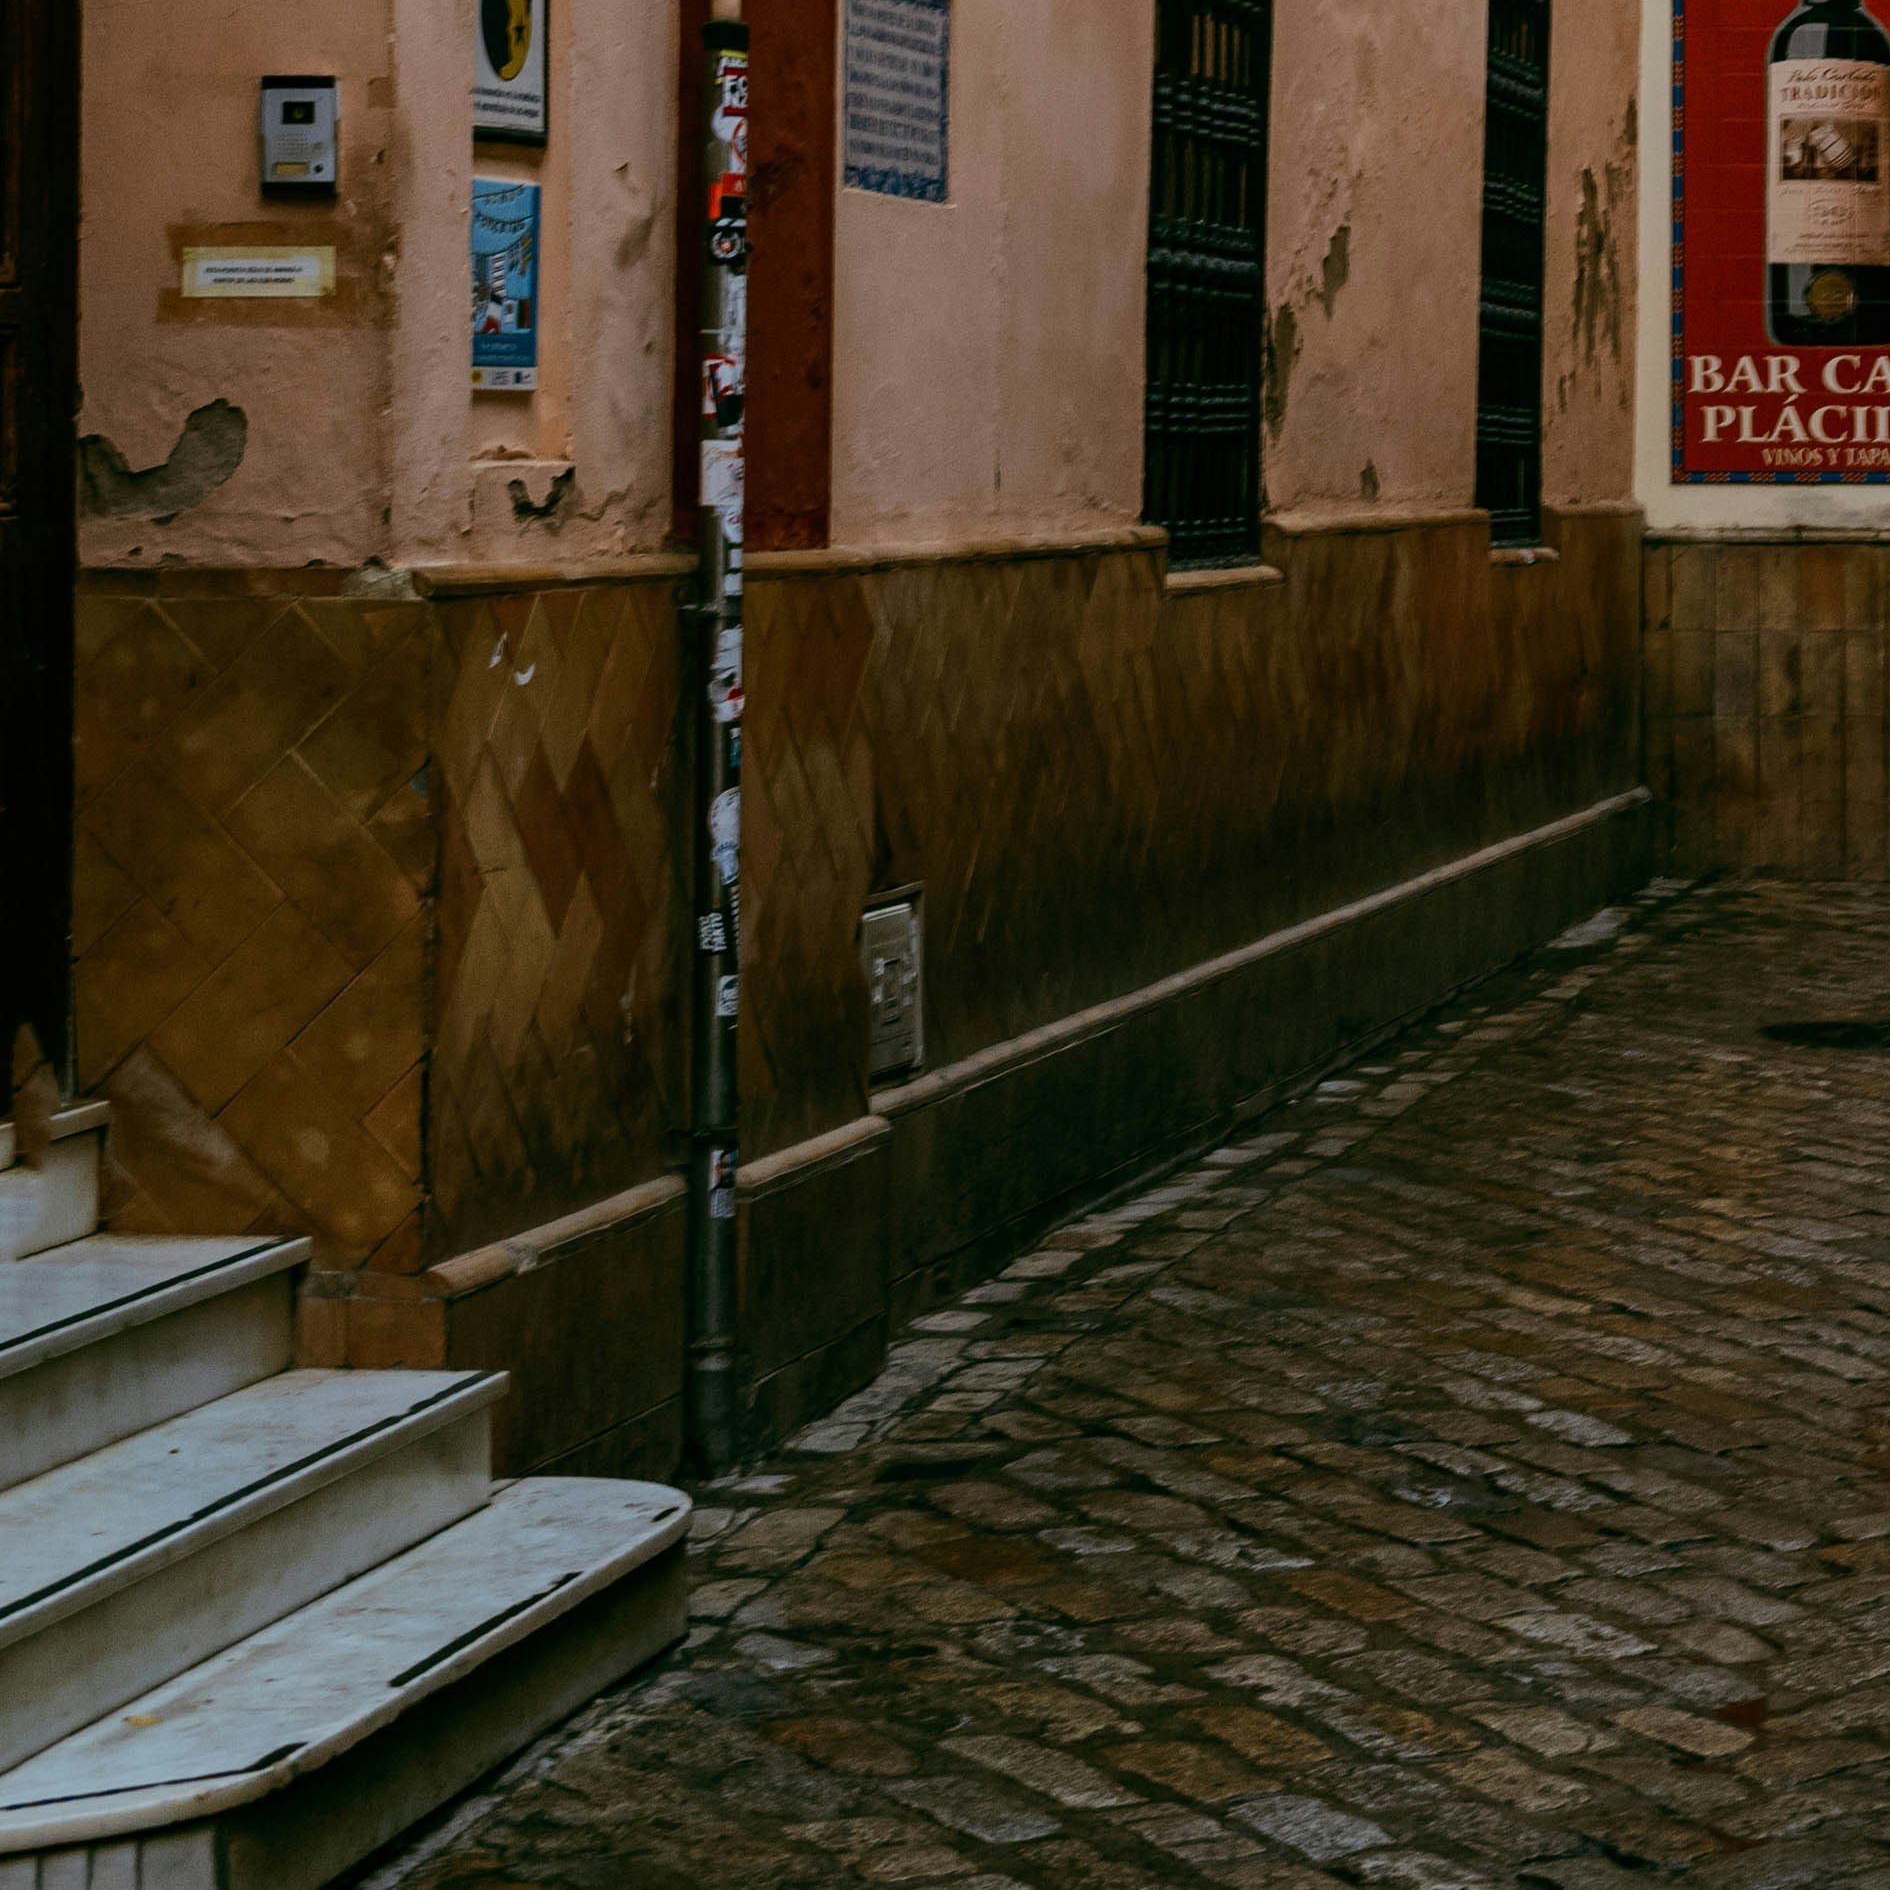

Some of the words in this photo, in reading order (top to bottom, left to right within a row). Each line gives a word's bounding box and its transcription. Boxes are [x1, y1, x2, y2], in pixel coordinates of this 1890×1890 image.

[1687, 354, 1808, 394] BAR
[1761, 447, 1824, 467] VINOS
[1827, 447, 1841, 466] Y
